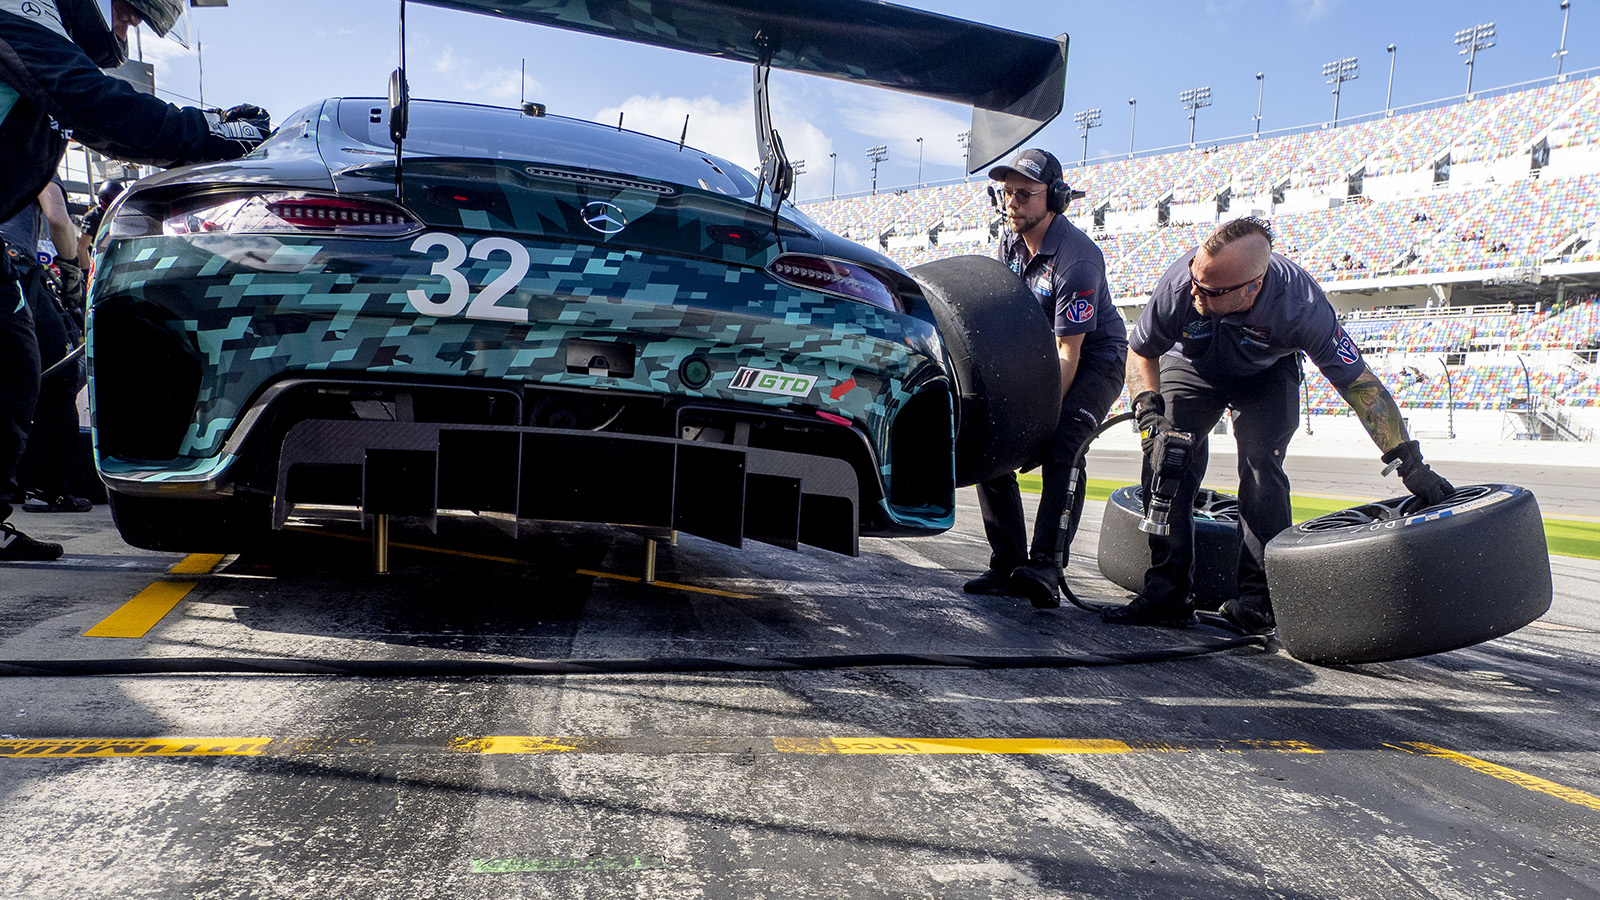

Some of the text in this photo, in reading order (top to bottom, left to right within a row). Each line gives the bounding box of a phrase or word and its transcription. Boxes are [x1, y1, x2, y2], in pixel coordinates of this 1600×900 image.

[406, 232, 530, 323] 32
[1068, 300, 1088, 321] VP
[1337, 337, 1357, 361] VP
[758, 374, 810, 393] GTD
